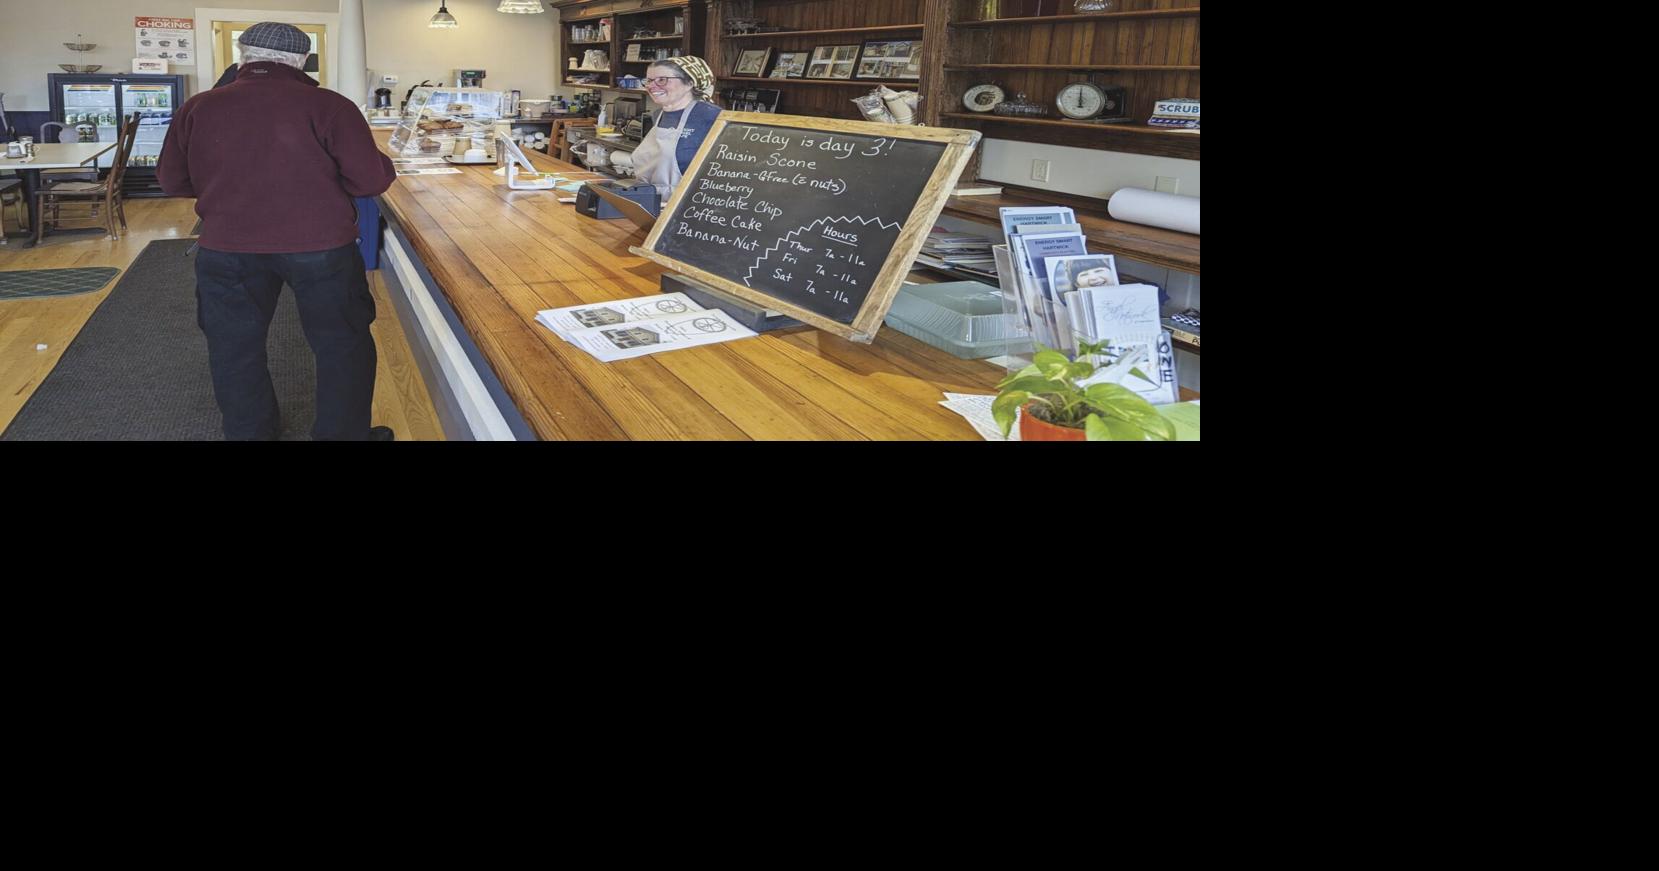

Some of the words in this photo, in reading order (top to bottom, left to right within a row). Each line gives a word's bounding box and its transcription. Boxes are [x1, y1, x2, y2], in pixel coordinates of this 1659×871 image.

[137, 20, 192, 29] CHOKING
[1158, 104, 1199, 113] SCRUB
[741, 126, 790, 150] Today
[800, 135, 814, 147] is
[819, 137, 855, 159] day
[716, 144, 757, 163] Raisin
[766, 152, 817, 170] Scone
[700, 179, 754, 199] Blueberry
[810, 178, 848, 195] nuts)
[692, 191, 748, 210] Chocolate
[754, 200, 783, 220] Chip
[683, 206, 727, 226] Coffee
[731, 216, 762, 231] Cake
[823, 225, 858, 242] Hours
[790, 240, 813, 253] Thur
[825, 248, 835, 259] 7a
[782, 252, 798, 264] Fri
[815, 264, 825, 276] 7a
[772, 268, 792, 282] Sat
[807, 280, 816, 294] 7a
